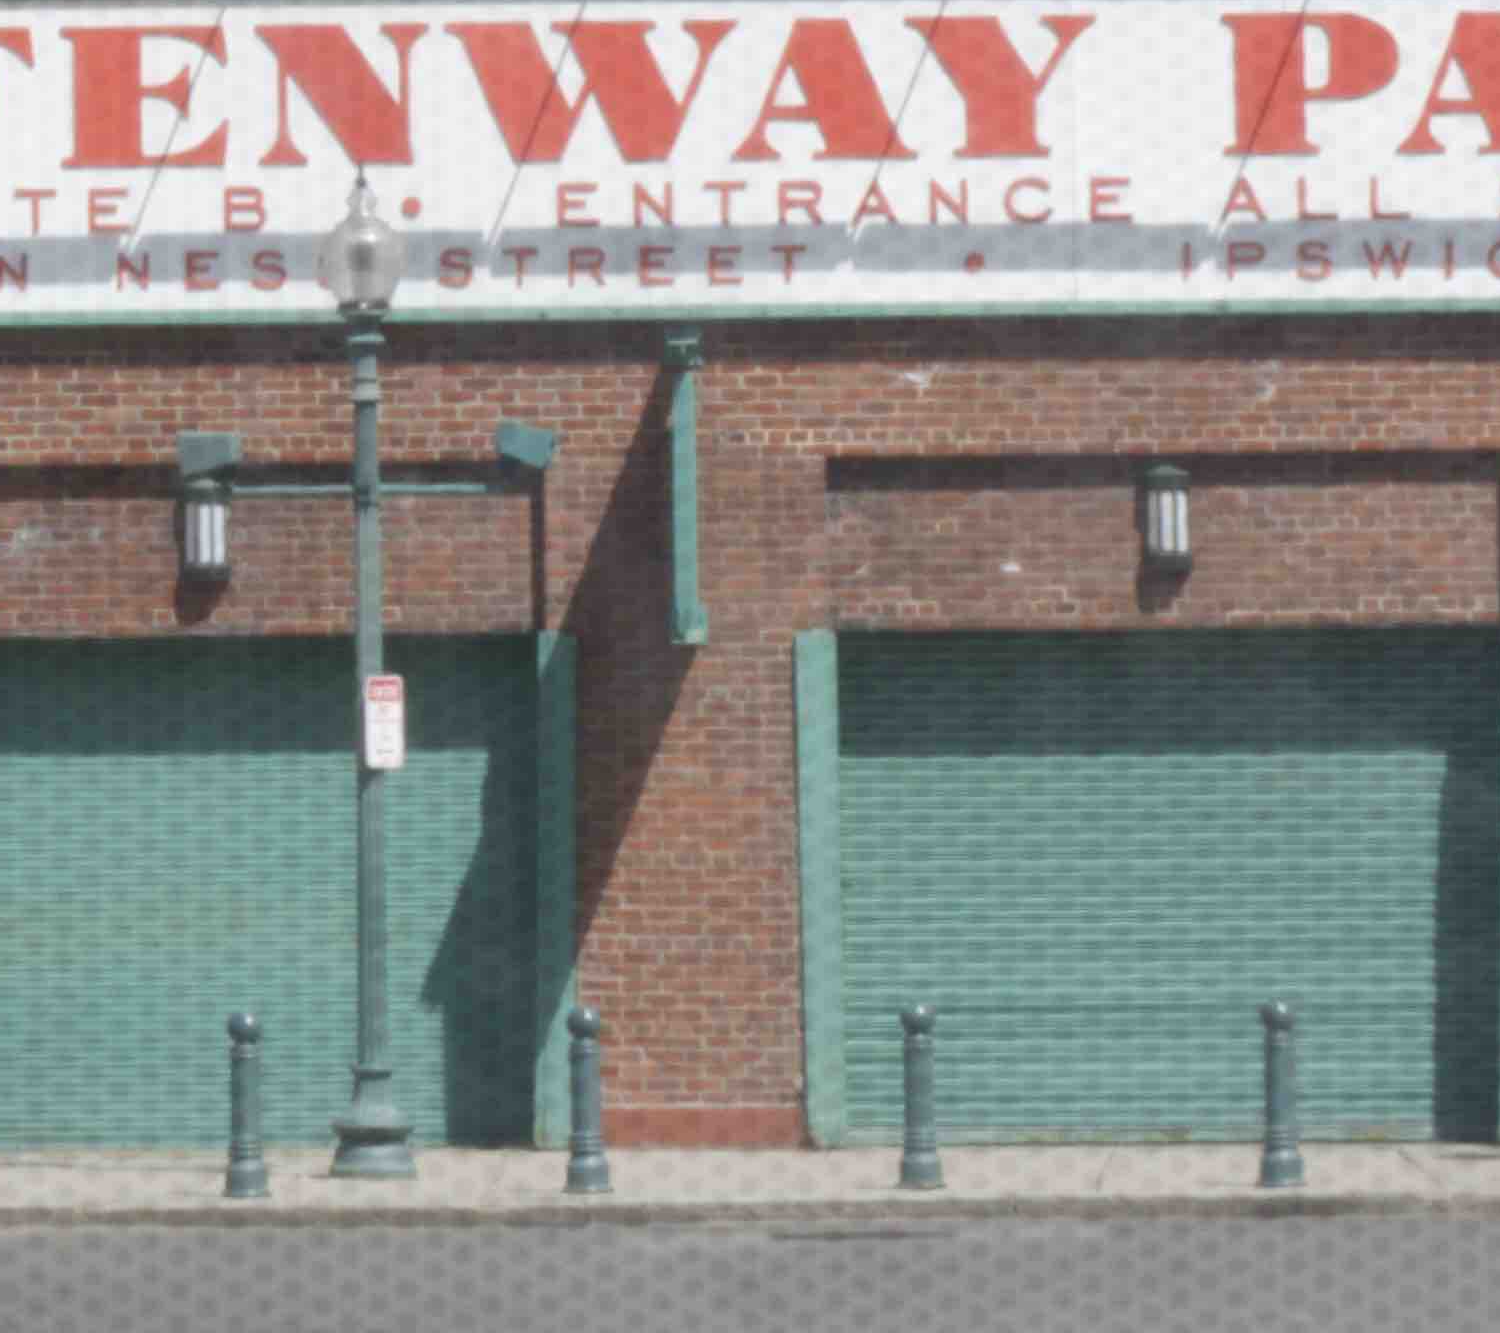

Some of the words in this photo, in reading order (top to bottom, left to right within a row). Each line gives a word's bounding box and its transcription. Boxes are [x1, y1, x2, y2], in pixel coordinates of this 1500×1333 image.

[223, 185, 266, 233] B
[558, 175, 1135, 230] ENTRANCE
[1221, 171, 1412, 221] ALL
[116, 247, 330, 291] NES
[438, 243, 808, 290] STREET
